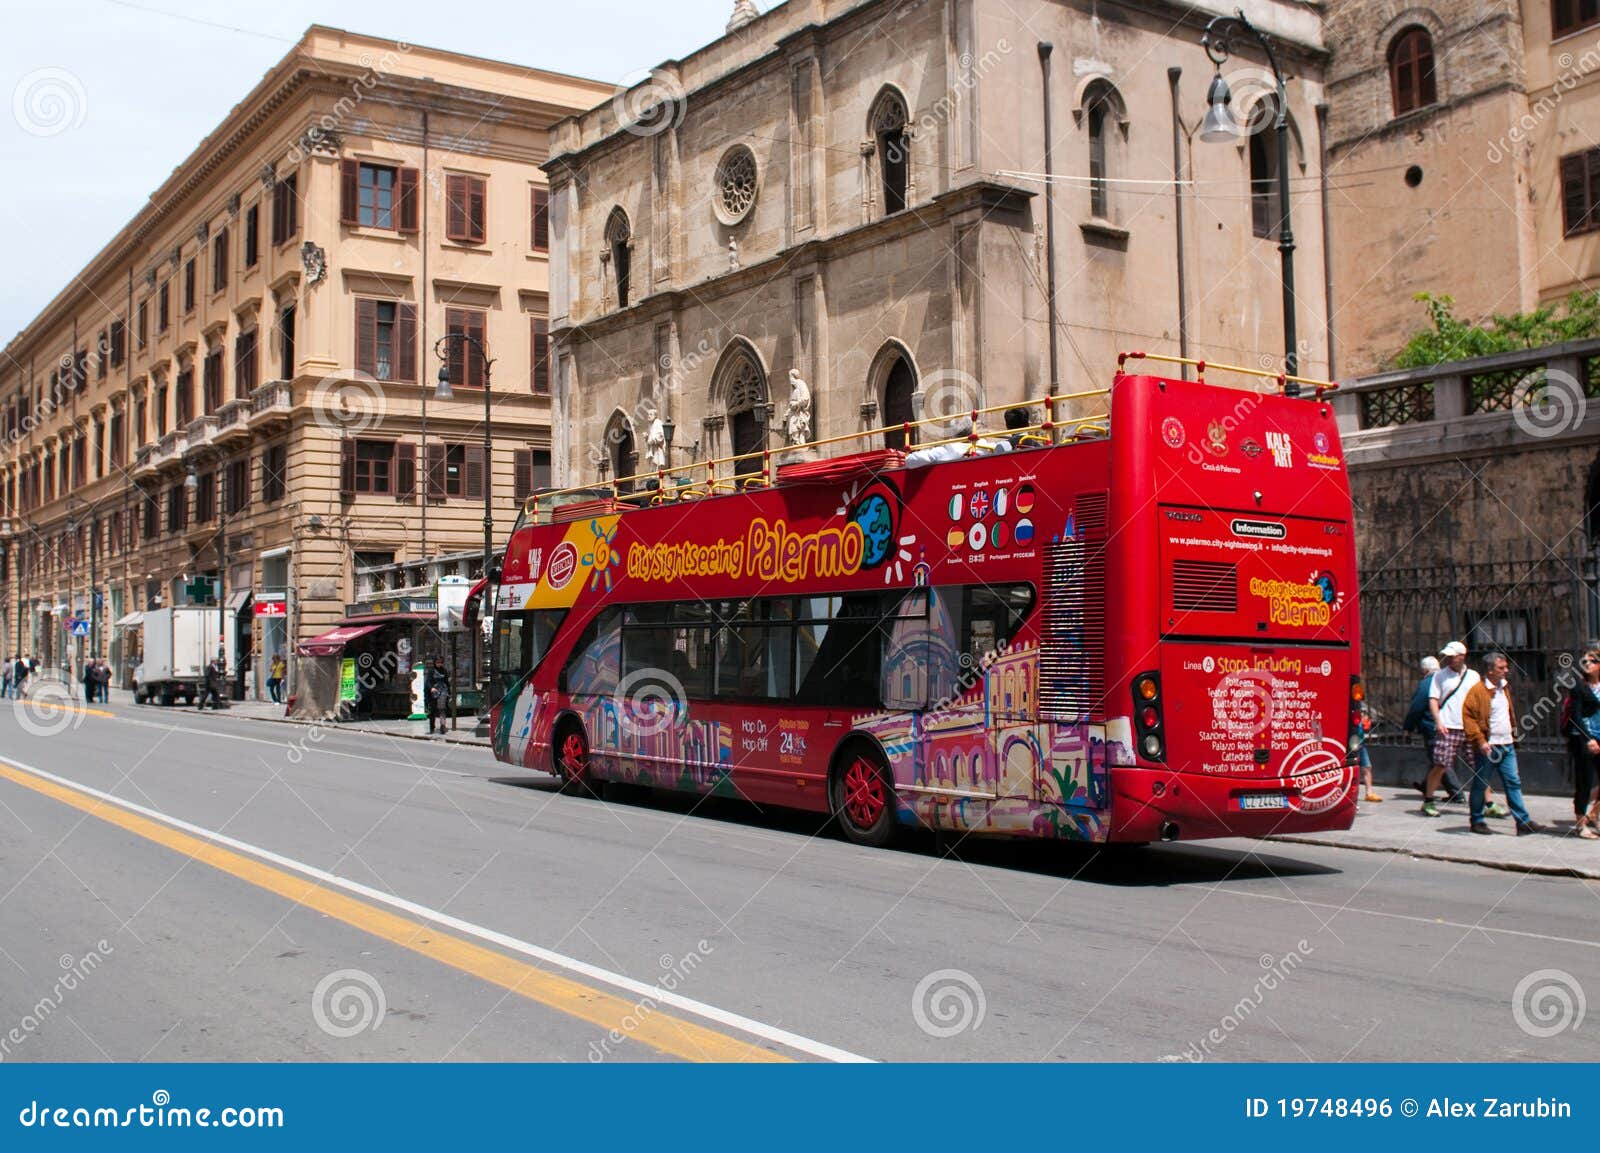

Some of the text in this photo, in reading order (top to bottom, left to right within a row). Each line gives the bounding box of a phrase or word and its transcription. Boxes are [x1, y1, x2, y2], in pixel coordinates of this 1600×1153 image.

[1265, 431, 1290, 451] KALS
[1274, 449, 1293, 468] ART
[1236, 523, 1283, 536] Information
[747, 517, 864, 583] Palermo
[1270, 596, 1330, 627] Palermo
[1183, 661, 1202, 671] Linea
[1217, 655, 1302, 675] Stops Including
[1305, 664, 1320, 674] Linea
[1207, 688, 1228, 697] Teatro
[742, 720, 755, 734] Hop
[757, 719, 766, 733] On
[1271, 720, 1295, 729] Mercato
[1296, 720, 1306, 729] del
[1199, 731, 1226, 741] Stazione
[1271, 730, 1290, 740] Teatro
[742, 738, 768, 752] Hop Off
[780, 731, 793, 754] 24
[1212, 741, 1235, 751] Palazzo
[1271, 740, 1289, 750] Porto
[1299, 742, 1324, 756] TOUR
[1202, 762, 1229, 773] Mercato
